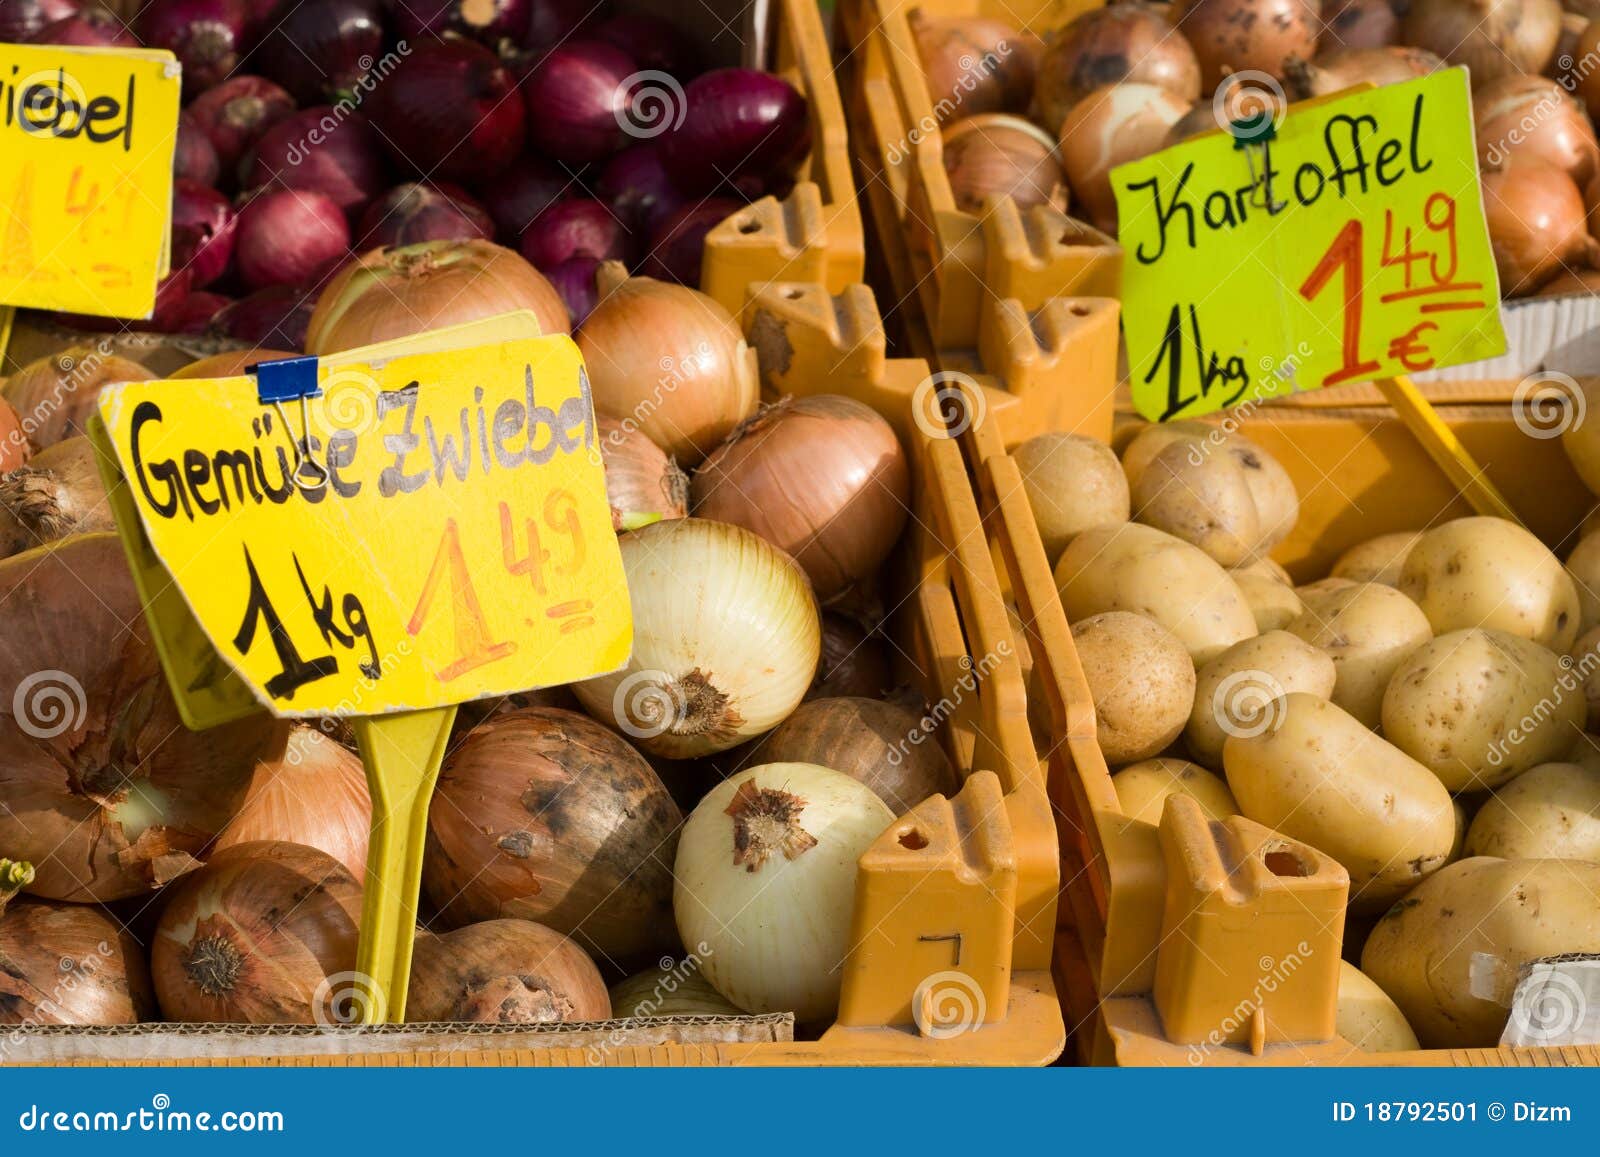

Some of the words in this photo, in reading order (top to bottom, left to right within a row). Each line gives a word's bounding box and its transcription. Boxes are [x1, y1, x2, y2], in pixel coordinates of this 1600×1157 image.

[0, 65, 135, 152] iebel
[1126, 94, 1432, 264] Kartoffel
[130, 401, 362, 522] Gemüse
[376, 363, 594, 498] Zwiebel
